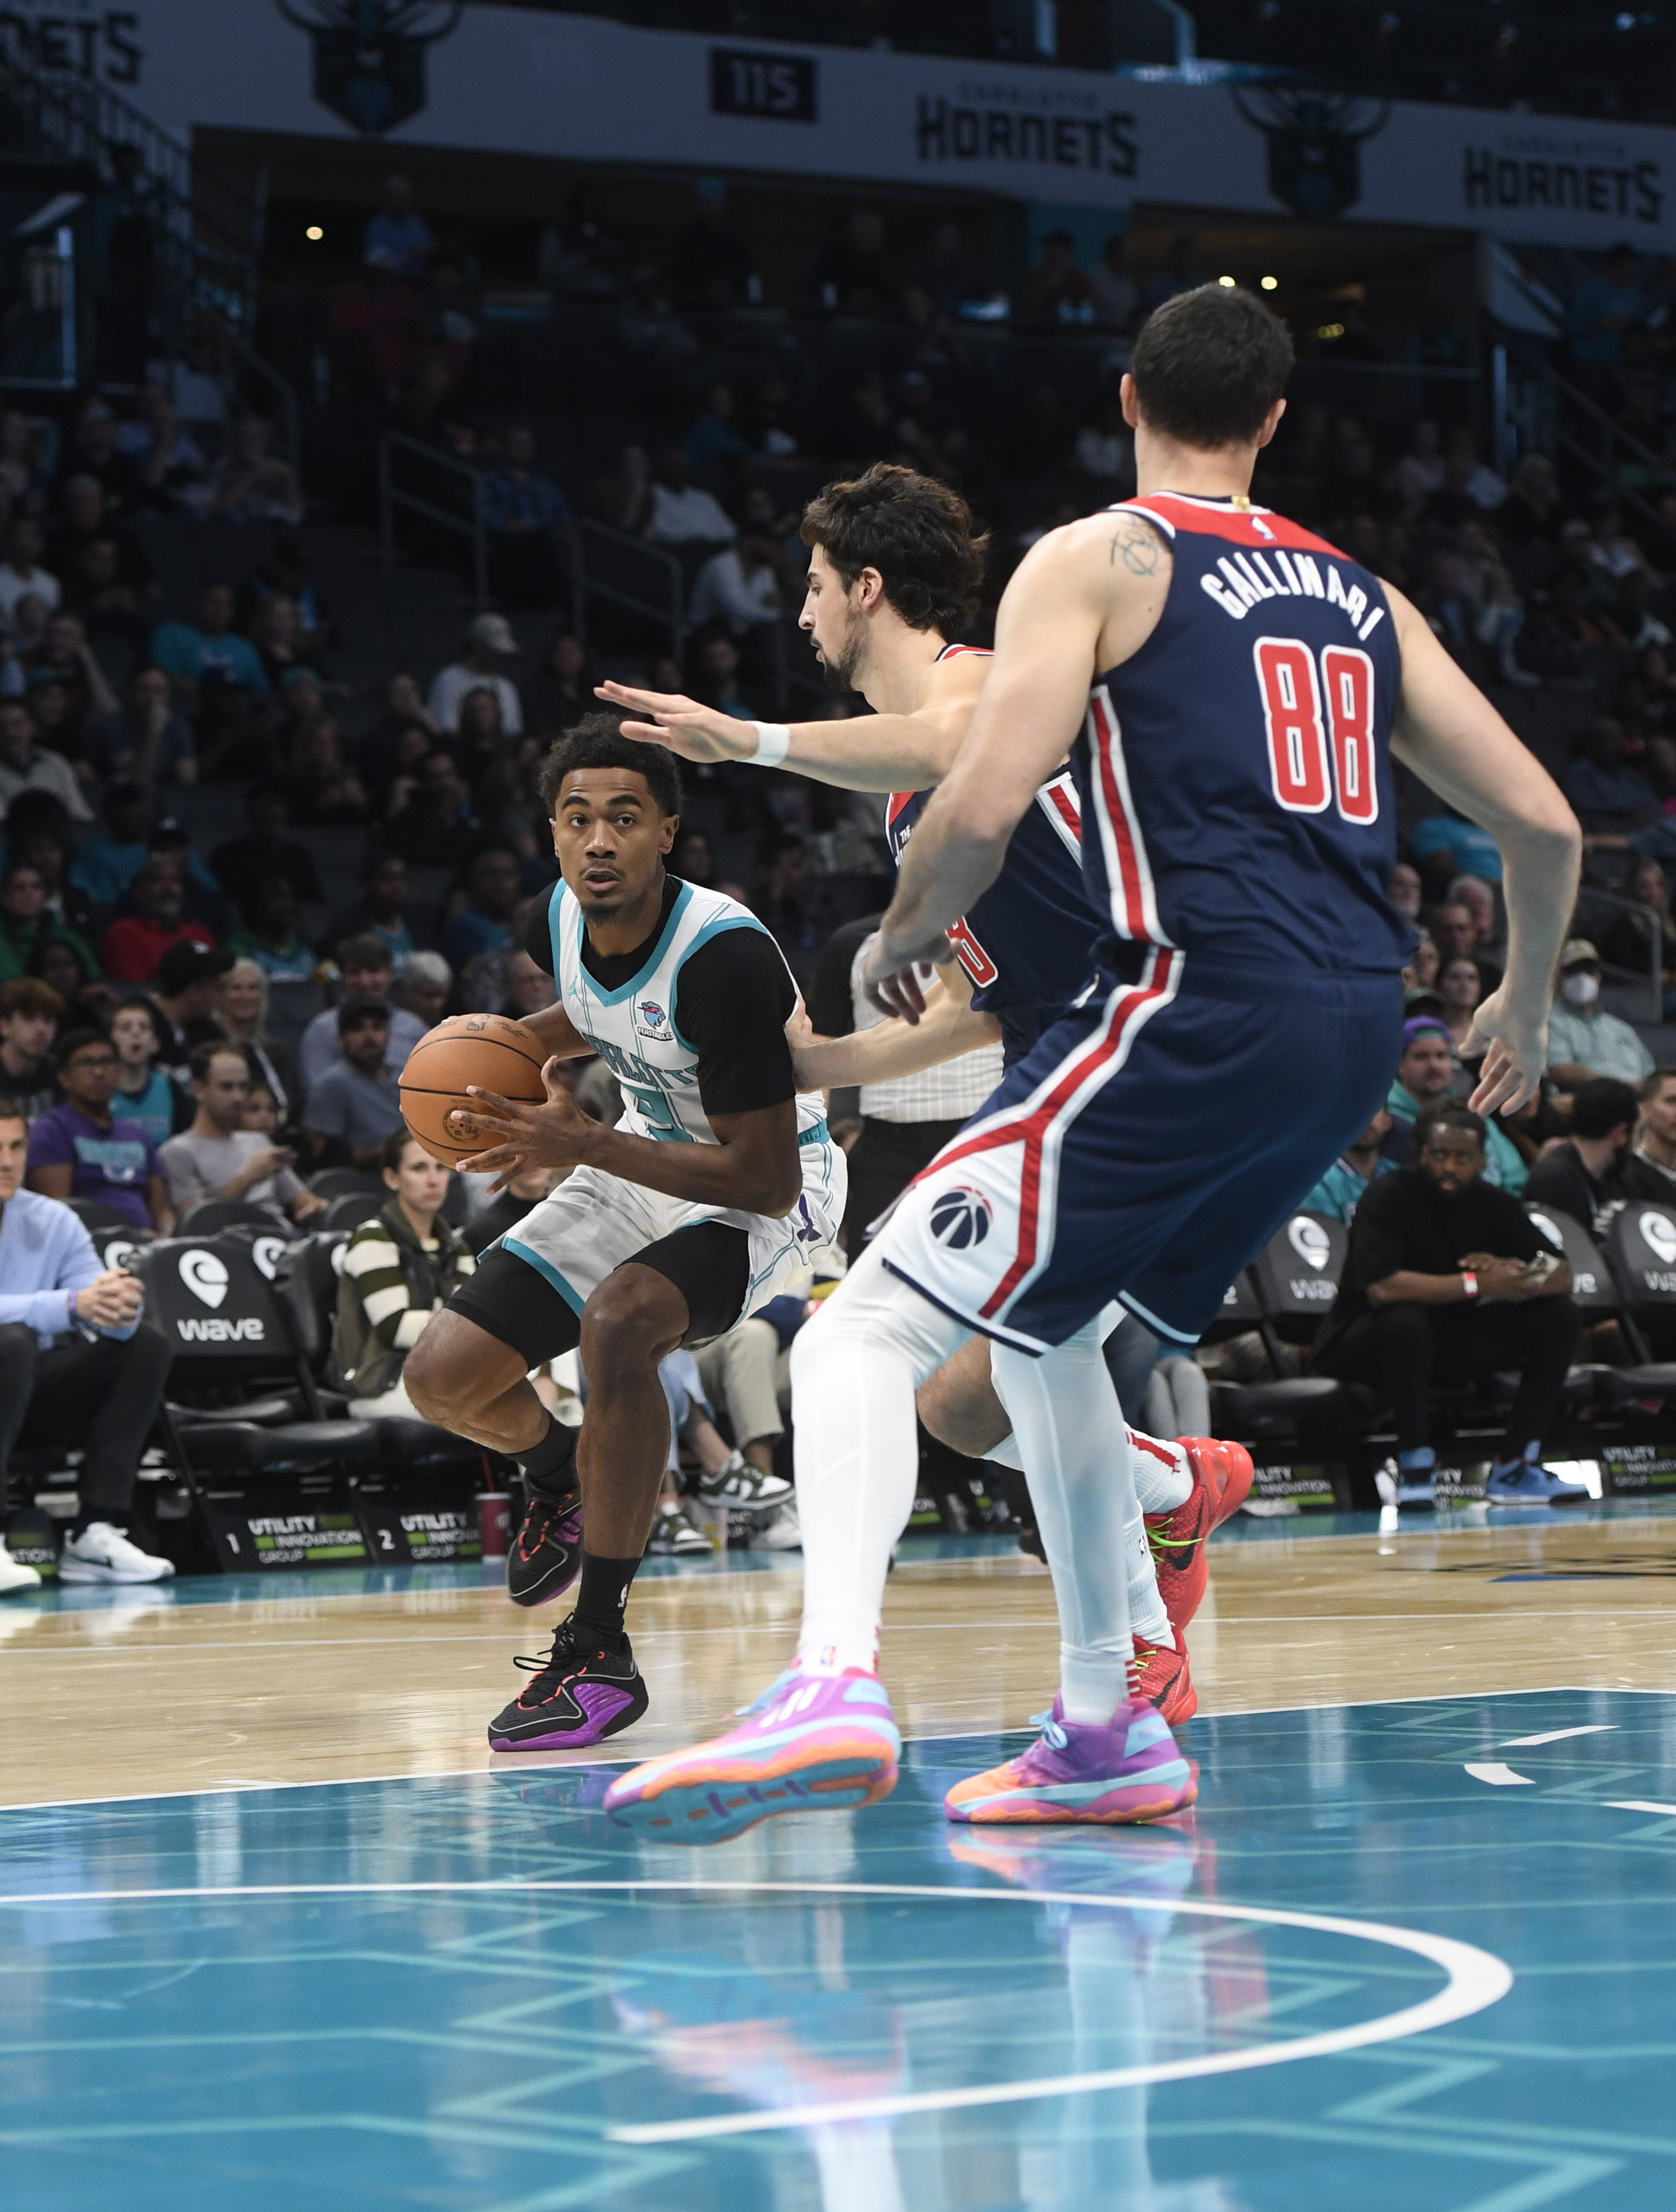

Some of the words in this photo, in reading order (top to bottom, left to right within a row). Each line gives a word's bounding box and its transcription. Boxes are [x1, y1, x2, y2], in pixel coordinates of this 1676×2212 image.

[730, 61, 800, 110] 115
[914, 93, 1140, 177] HORNETS
[1463, 147, 1665, 224] HORNETS
[1201, 551, 1384, 641] GALLINARI
[1253, 636, 1378, 825] 88
[637, 1026, 674, 1041] FEASTABLES
[177, 1318, 264, 1341] wave
[248, 1515, 316, 1535] UTILITY
[400, 1512, 467, 1532] UTILITY
[227, 1532, 241, 1554] 1
[275, 1529, 363, 1549] INNOVATION
[377, 1529, 396, 1550] 2
[258, 1548, 304, 1563] GROUP
[411, 1544, 457, 1559] GROUP
